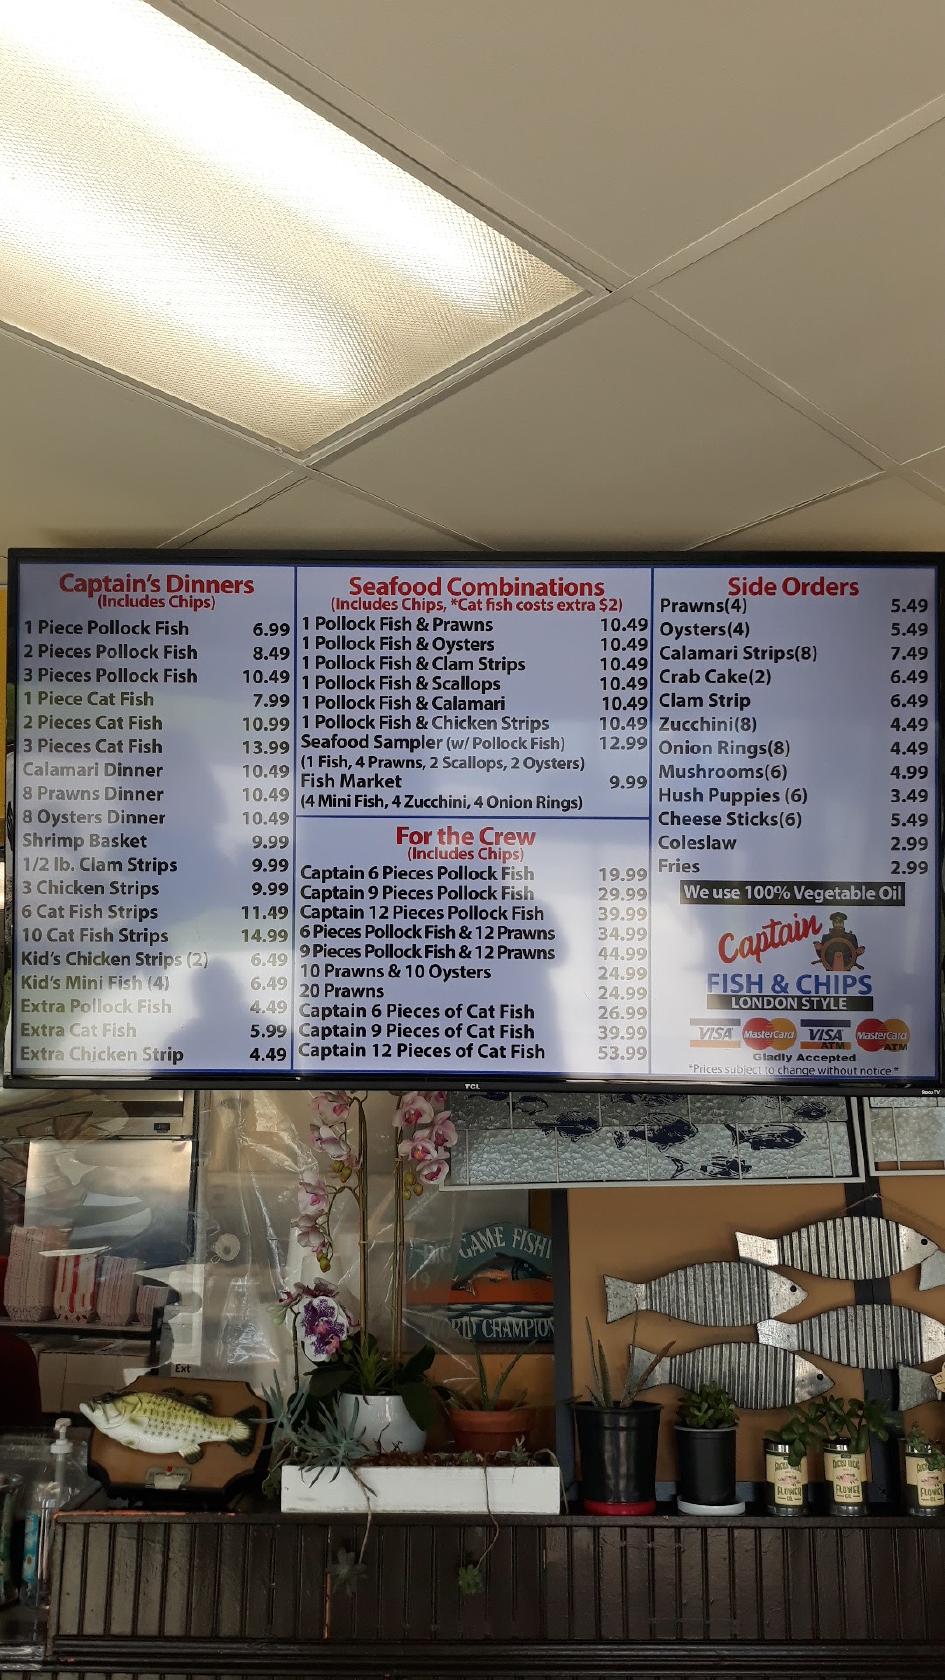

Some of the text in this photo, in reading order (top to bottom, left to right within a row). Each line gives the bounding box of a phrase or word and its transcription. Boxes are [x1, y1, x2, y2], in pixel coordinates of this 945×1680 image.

[60, 573, 254, 598] Captain's Dinners
[350, 576, 604, 598] Seafood Combinations
[728, 576, 859, 596] Side Orders
[98, 594, 215, 612] (Includes Chips)
[332, 597, 398, 612] (Includes
[402, 598, 446, 613] Chips,
[486, 598, 512, 611] fish
[516, 599, 553, 611] costs
[557, 599, 595, 611] extra
[599, 598, 622, 613] $2)
[661, 598, 928, 614] Prawns(4) 5.49
[25, 620, 290, 636] 1 Piece Pollock Fish 6.99
[303, 616, 648, 631] 1 Pollock Fish & Prawns 10.49
[660, 622, 928, 640] Oysters(4) 5.49
[660, 645, 928, 663] Calamari Strips(8) 7.49
[303, 655, 648, 675] 1 Pollock Fish & Clam Strips 10.49
[24, 668, 290, 683] 3 Pieces Pollock Fish 10.49
[660, 669, 928, 685] Crab Cake(2) 6.49
[659, 693, 928, 711] Clam Strip 6.49
[659, 717, 928, 733] Zucchini(8) 4.49
[659, 740, 928, 759] Onion Rings(8) 4.49
[301, 755, 584, 772] (1 Fish, 4 Prawns, 2 Scallops, 2 Oysters)
[659, 764, 928, 781] Mushrooms(6) 4.99
[659, 787, 928, 806] Hush Puppies (6) 3.49
[659, 811, 928, 828] Cheese Sticks(6) 5.49
[23, 832, 289, 851] Shrimp Basket 9.99
[397, 826, 536, 847] For the Crew
[658, 835, 928, 851] Coleslaw 2.99
[408, 847, 523, 863] (Includes Chips)
[24, 856, 289, 875] 1/2 lb. Clam Strips 9.99
[659, 858, 928, 874] Fries 2.99
[22, 880, 288, 899] 3 Chicken Strips 9.99
[684, 885, 901, 902] We use 100% Vegetable Oil
[23, 927, 288, 946] 10 Cat Fish Strips 14.99
[719, 913, 822, 964] Captain
[300, 984, 647, 999] 20 Prawns 24.99
[707, 974, 872, 994] FISH & CHIPS
[732, 997, 847, 1010] LONDON STYLE
[699, 1027, 907, 1041] VISA MasterCard VISA MasterCard
[20, 1046, 286, 1065] Extra Chicken Strip 4.49
[299, 1043, 647, 1061] Captain 12 Pieces of Cat Fish 53.99
[884, 1043, 907, 1051] ATM
[753, 1053, 856, 1063] Gladly Accepted
[778, 1066, 815, 1075] change
[818, 1066, 857, 1074] without
[459, 1226, 505, 1258] GAME
